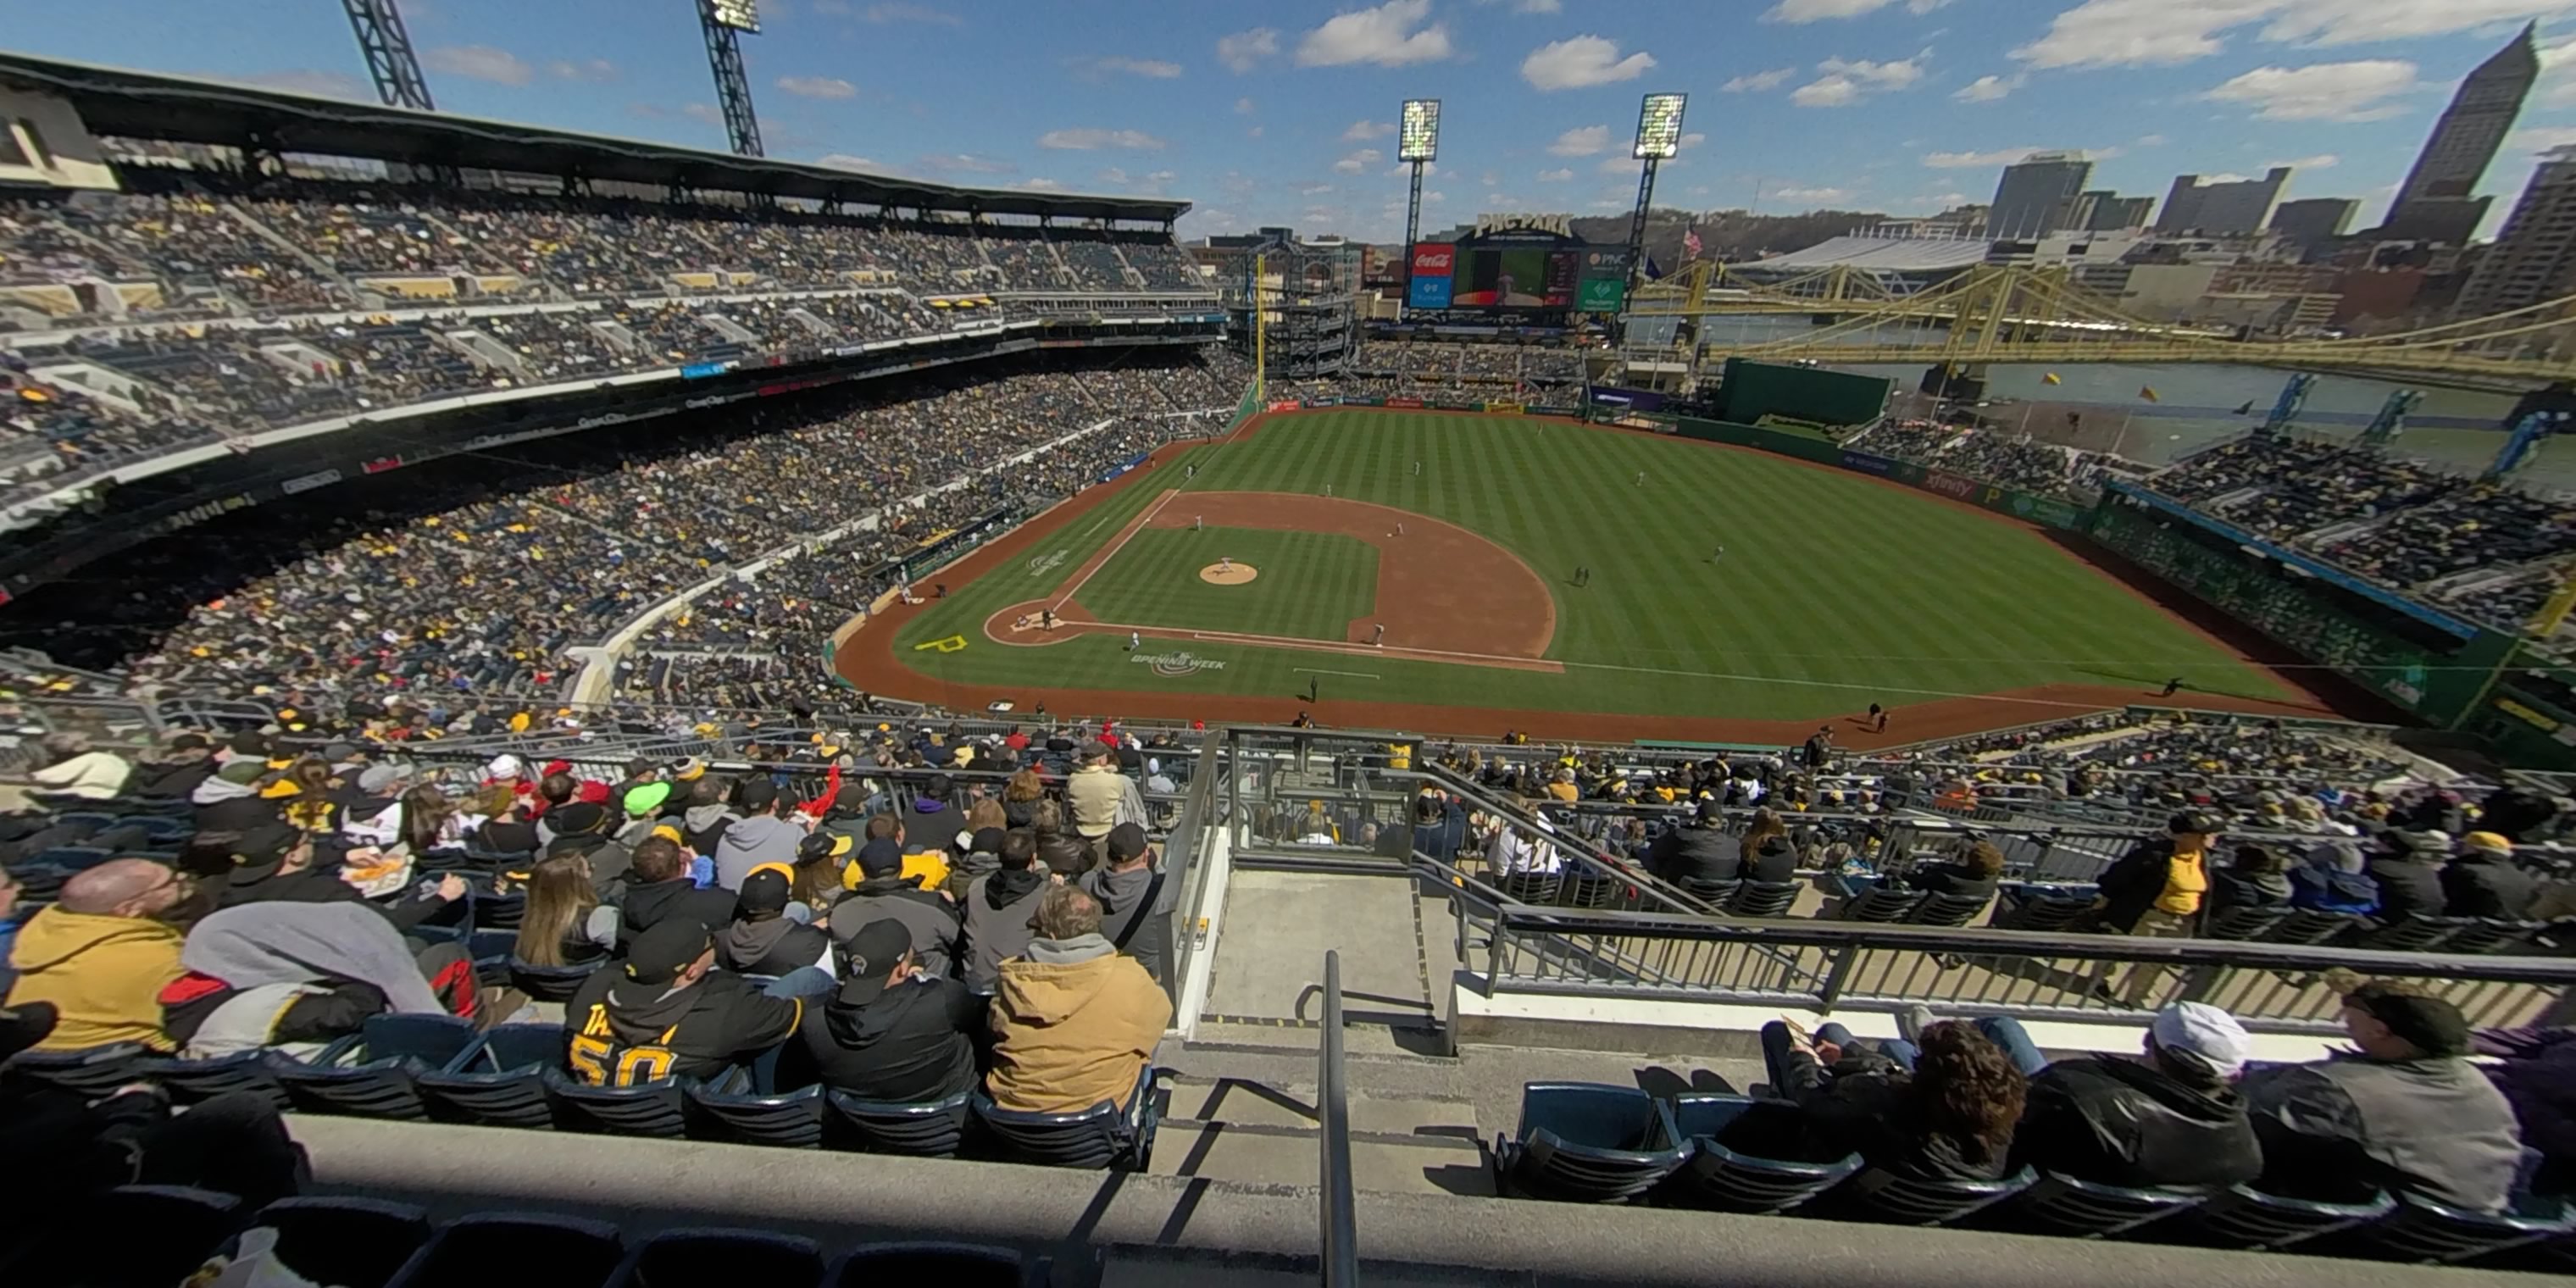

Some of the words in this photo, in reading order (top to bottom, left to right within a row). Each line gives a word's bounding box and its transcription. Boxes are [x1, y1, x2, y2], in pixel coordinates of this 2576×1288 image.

[1474, 213, 1517, 239] PNC
[1519, 212, 1574, 238] PARK
[1602, 253, 1627, 264] PNC
[1926, 473, 1974, 497] xfinity
[1130, 653, 1187, 666] OPENING
[1189, 658, 1227, 670] WEEK
[569, 1034, 679, 1087] 50
